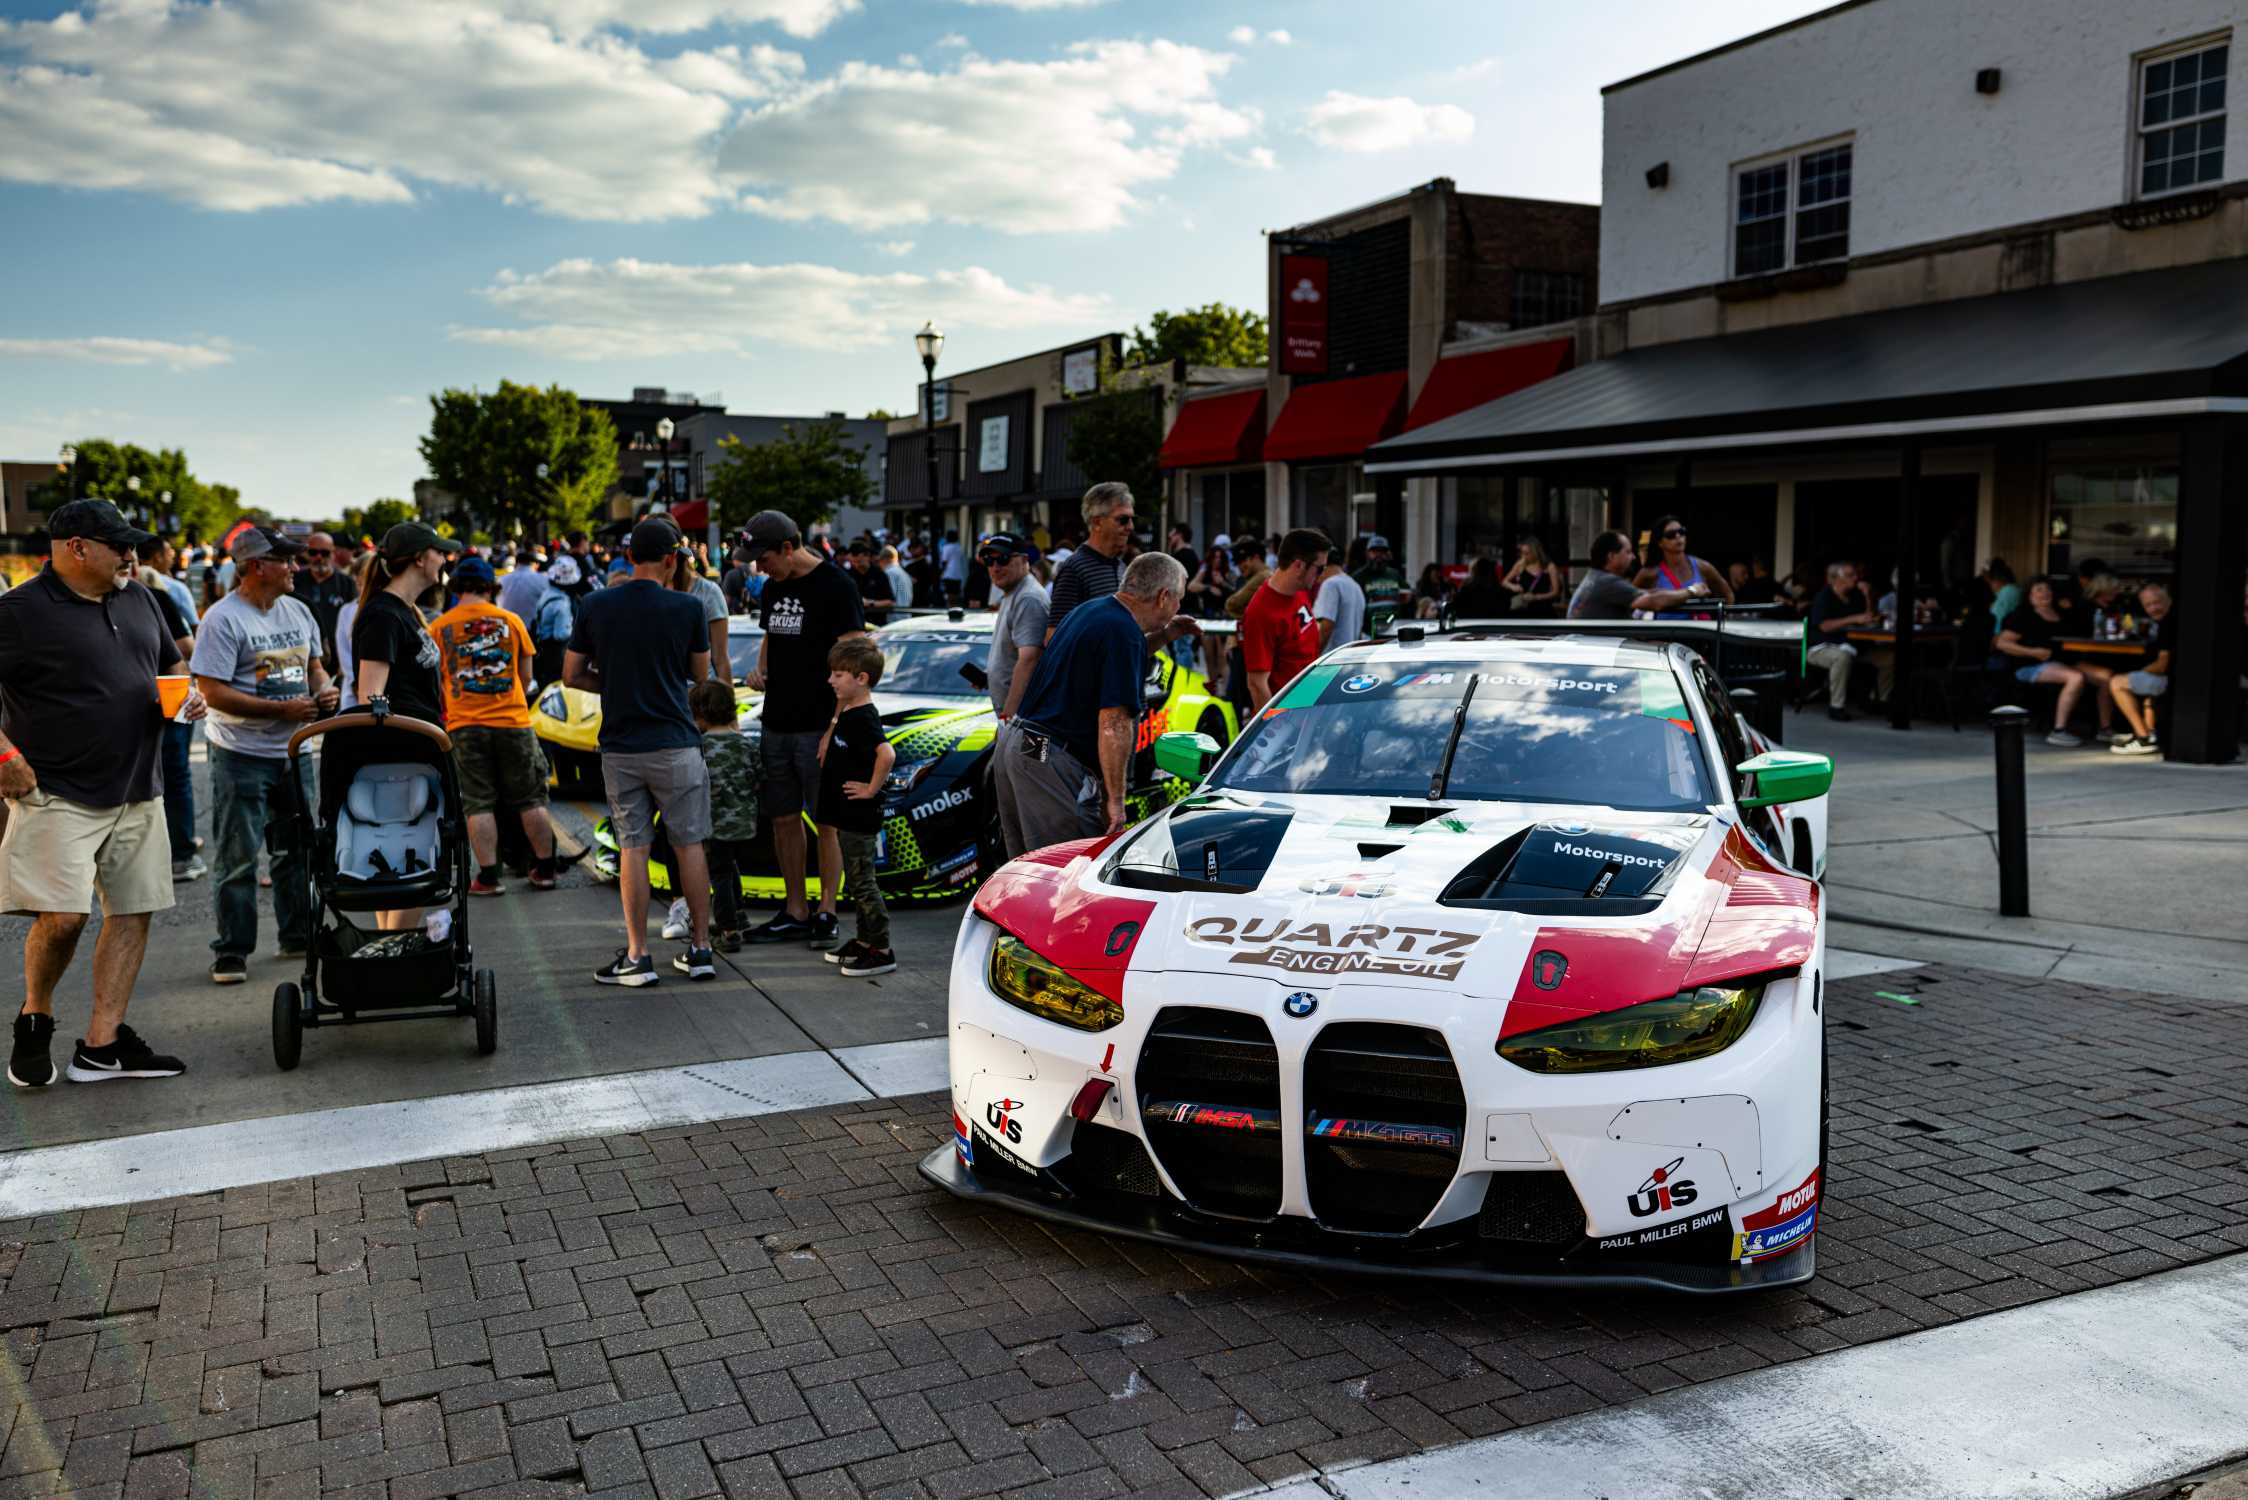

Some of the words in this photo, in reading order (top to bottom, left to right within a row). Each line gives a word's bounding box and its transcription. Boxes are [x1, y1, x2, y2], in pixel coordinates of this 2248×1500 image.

[769, 615, 802, 628] SKUSA
[1464, 672, 1618, 694] Motorsport
[911, 787, 973, 821] molex
[1553, 842, 1665, 869] Motorsport
[1183, 916, 1482, 959] QUARTZ
[1267, 950, 1384, 971] ENGINE
[1195, 1107, 1256, 1131] IMSA
[973, 1122, 990, 1145] PAUL
[989, 1139, 1016, 1165] MILLER
[1778, 1179, 1816, 1216] MOTUL
[1600, 1237, 1636, 1250] PAUL
[1639, 1224, 1688, 1245] MILLER
[1692, 1210, 1724, 1230] BMW
[1766, 1215, 1814, 1246] MICHELIN
